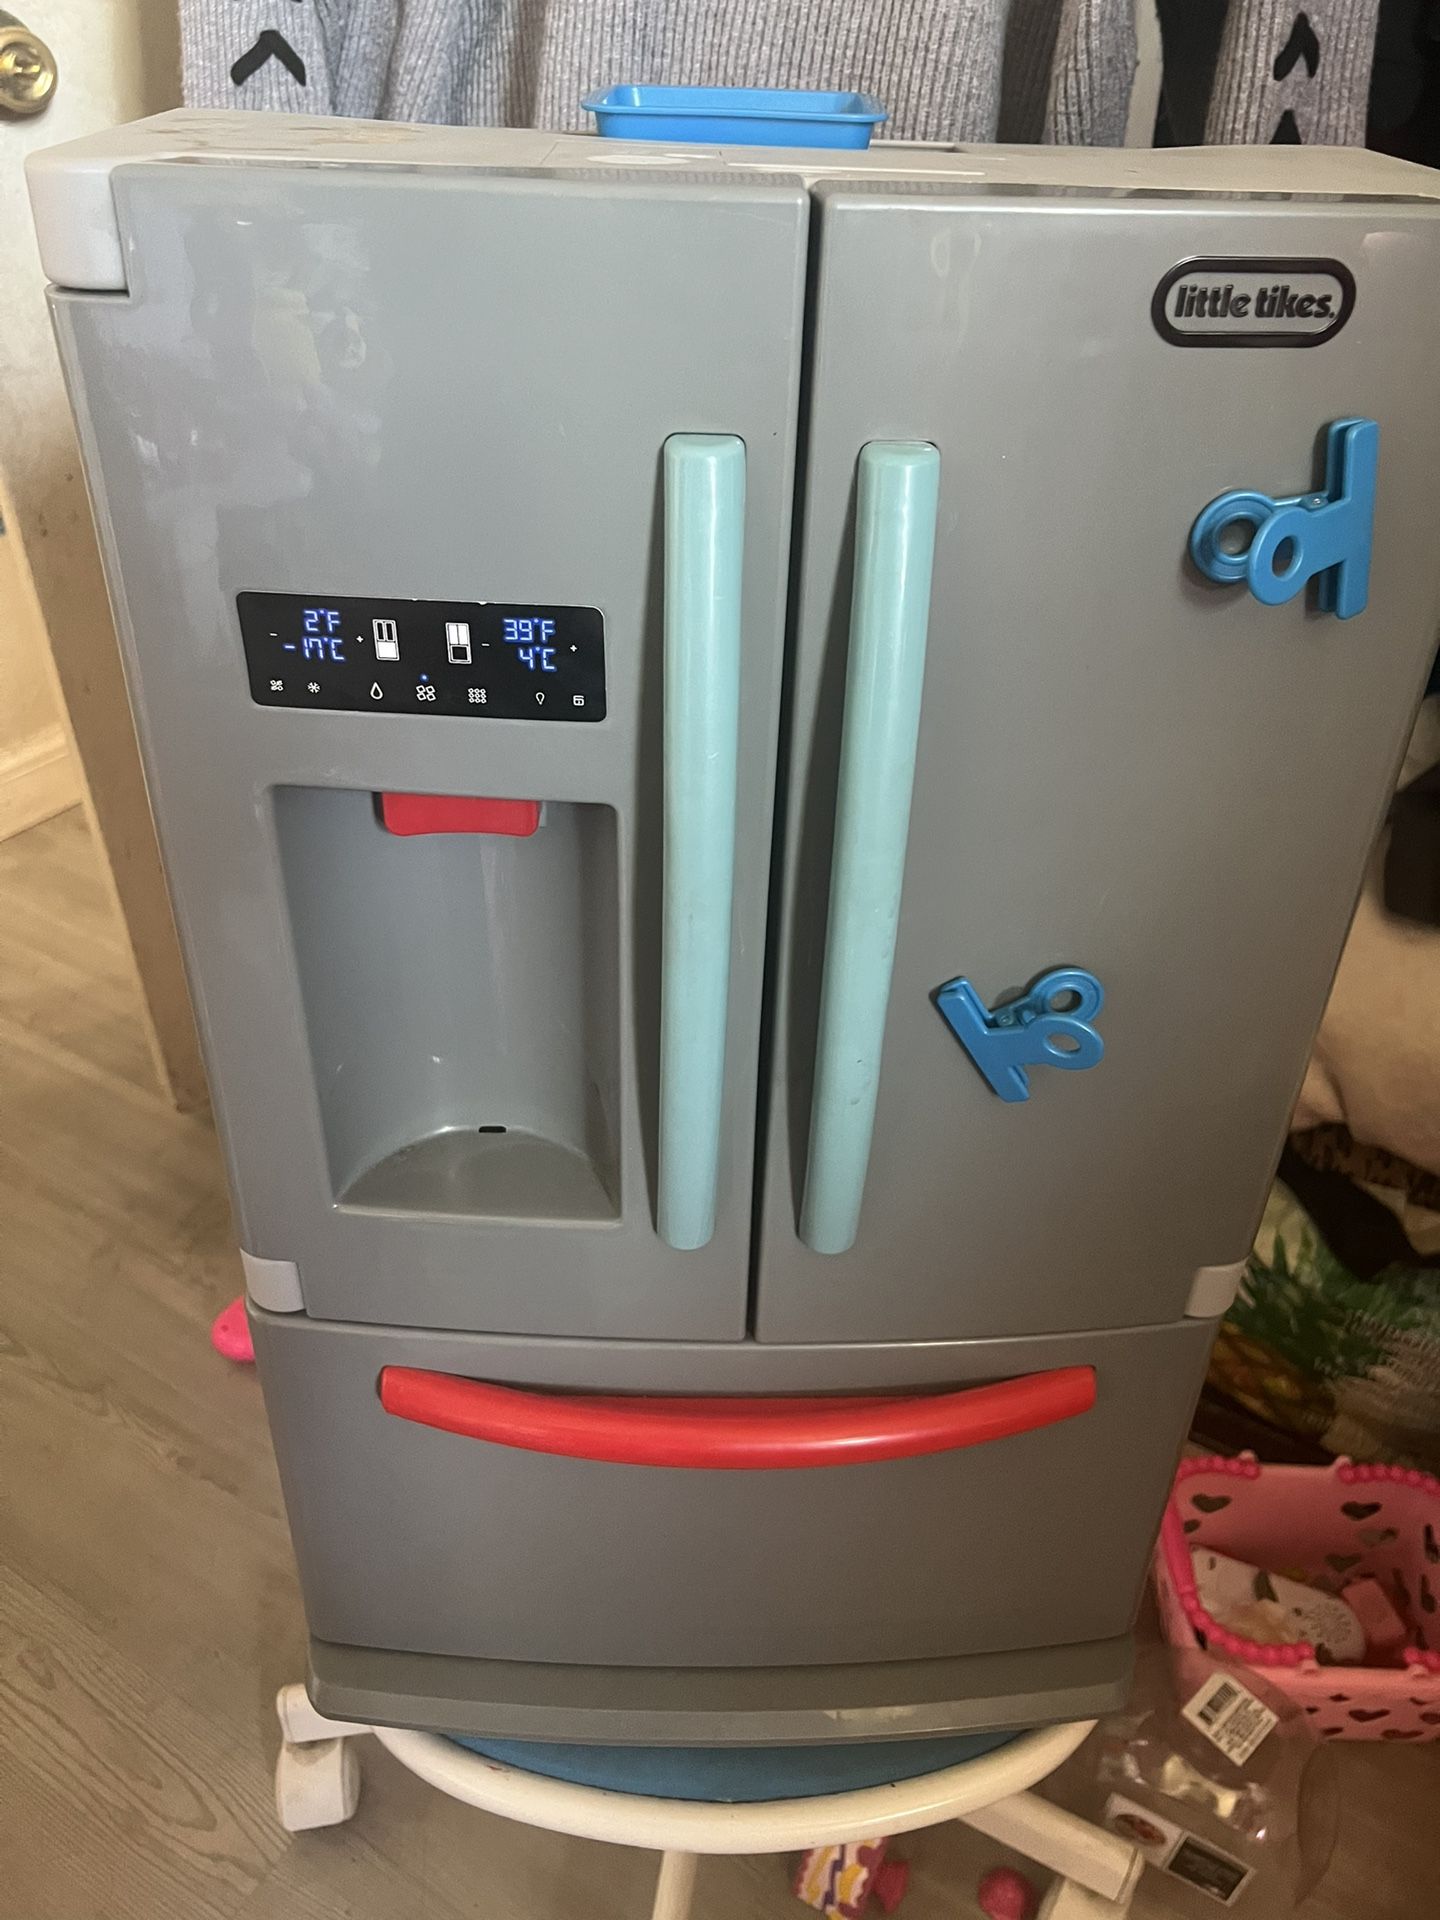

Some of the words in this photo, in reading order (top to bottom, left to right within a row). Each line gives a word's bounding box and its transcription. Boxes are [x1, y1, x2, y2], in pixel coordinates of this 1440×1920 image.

[1174, 284, 1251, 318] little
[303, 609, 341, 632] 2°F
[503, 617, 555, 641] 39°F
[518, 646, 556, 670] 4°C
